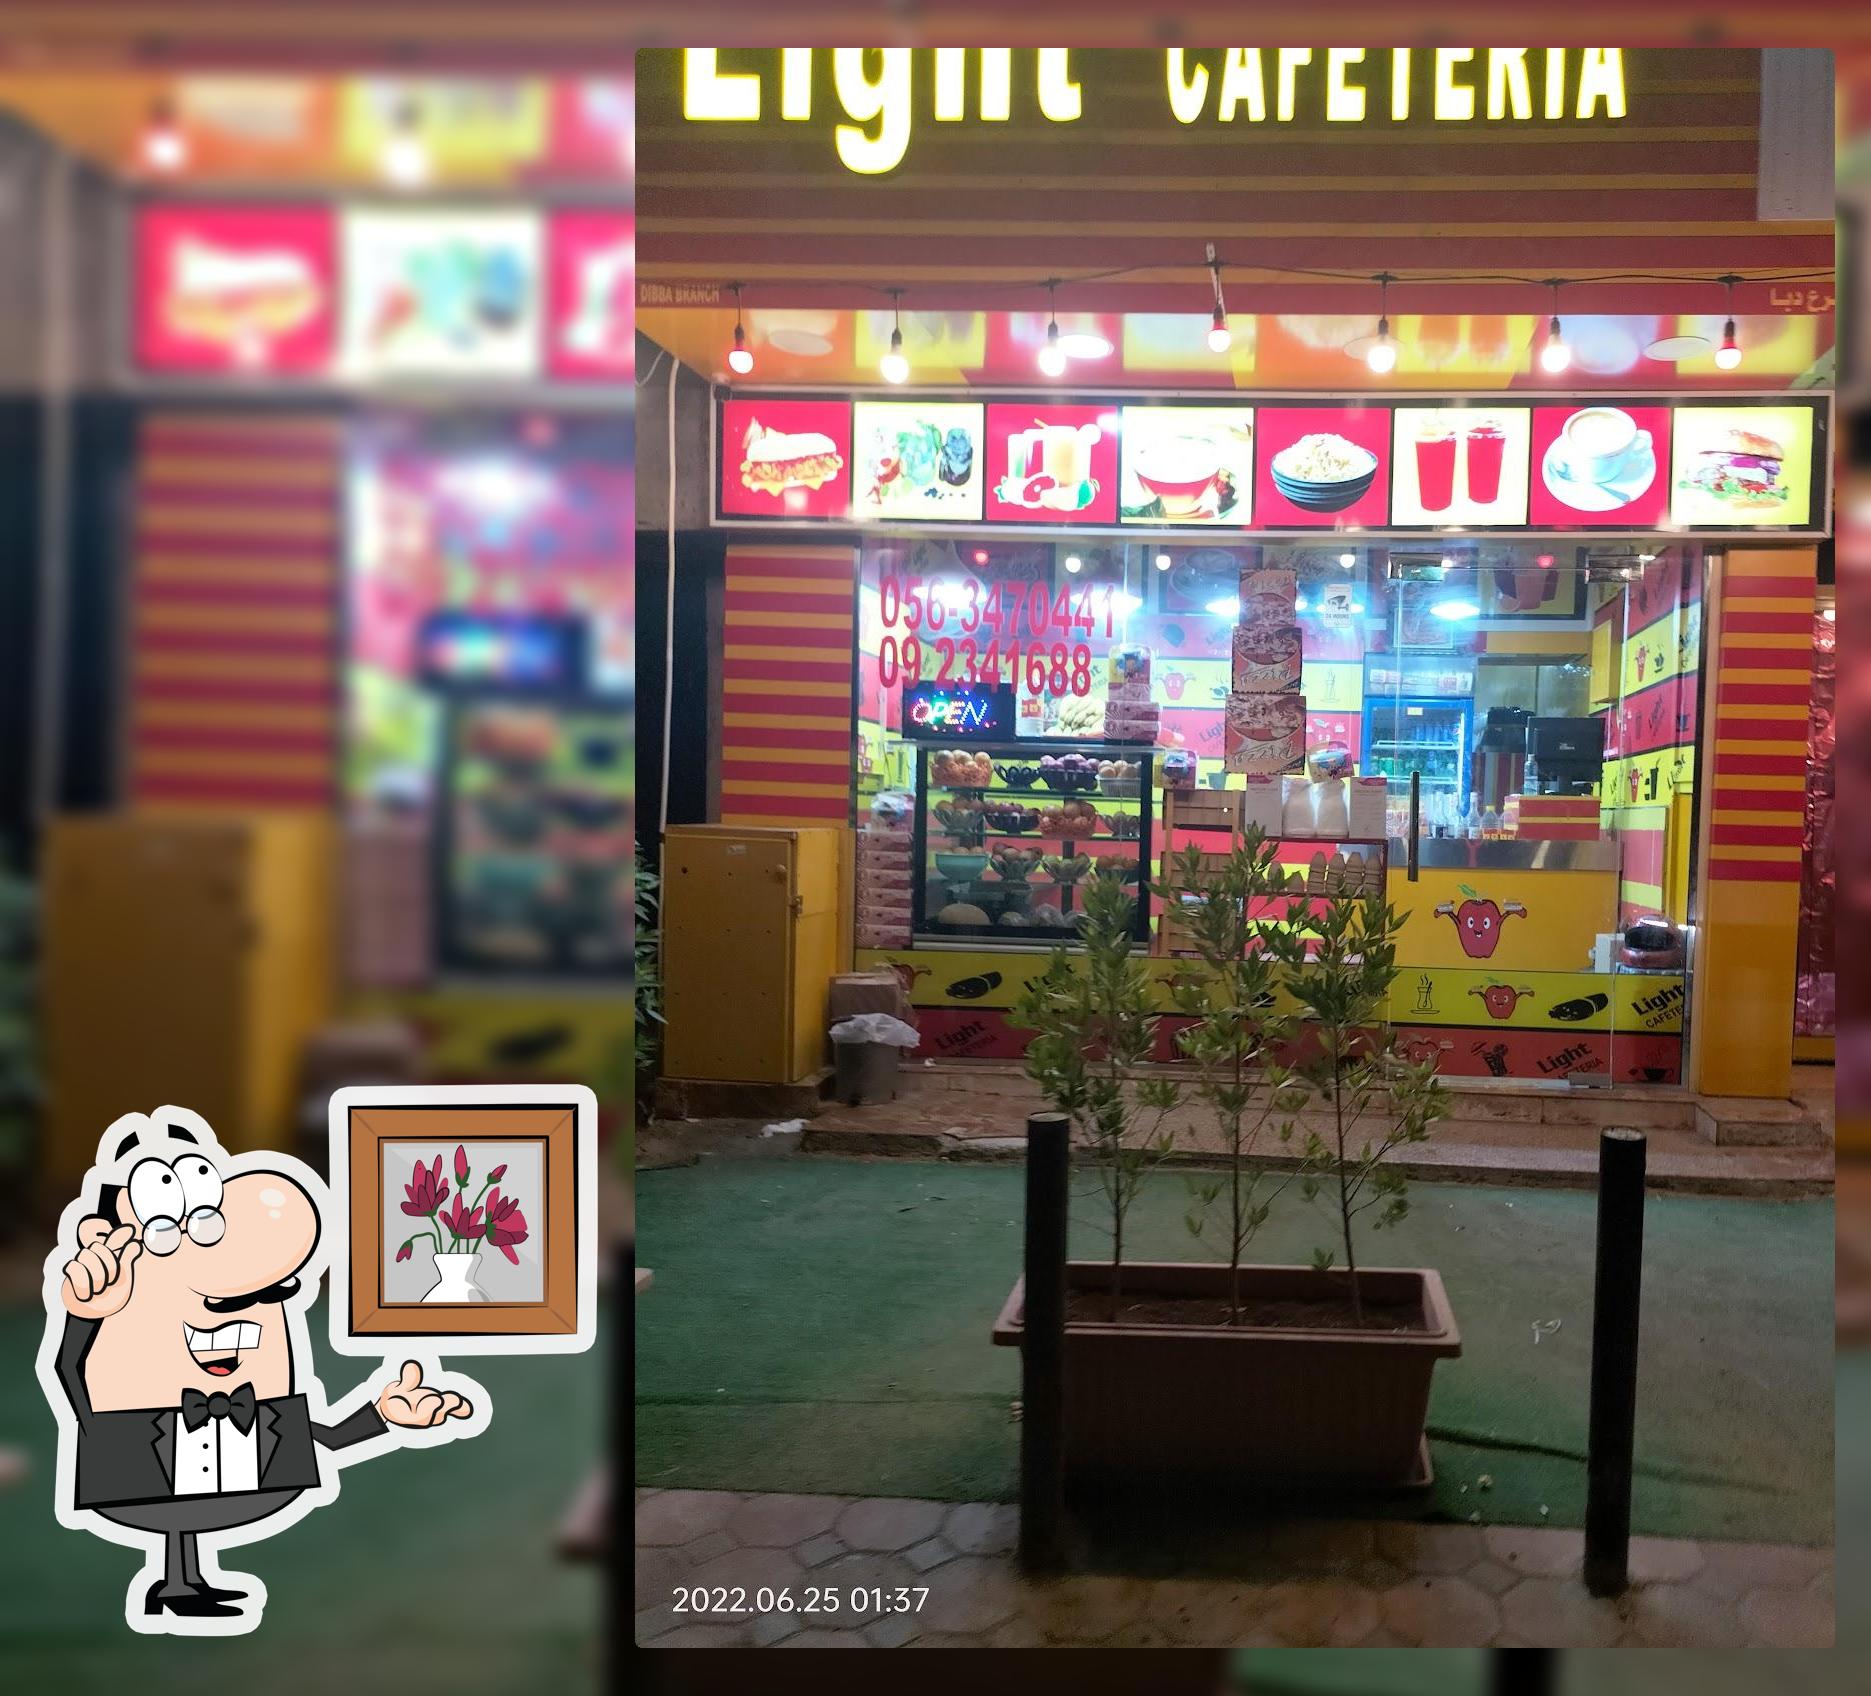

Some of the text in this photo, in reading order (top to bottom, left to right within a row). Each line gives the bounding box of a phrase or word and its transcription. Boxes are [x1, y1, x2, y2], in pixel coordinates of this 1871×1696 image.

[1166, 48, 1627, 123] CAFETERIA
[640, 283, 720, 304] DIBBA BRANCH
[879, 575, 1114, 639] 056-3470441
[879, 635, 922, 690] 09
[935, 637, 1092, 697] 2341688
[911, 697, 988, 726] OPEN
[1632, 984, 1684, 1016] Light
[1537, 1043, 1592, 1073] Light
